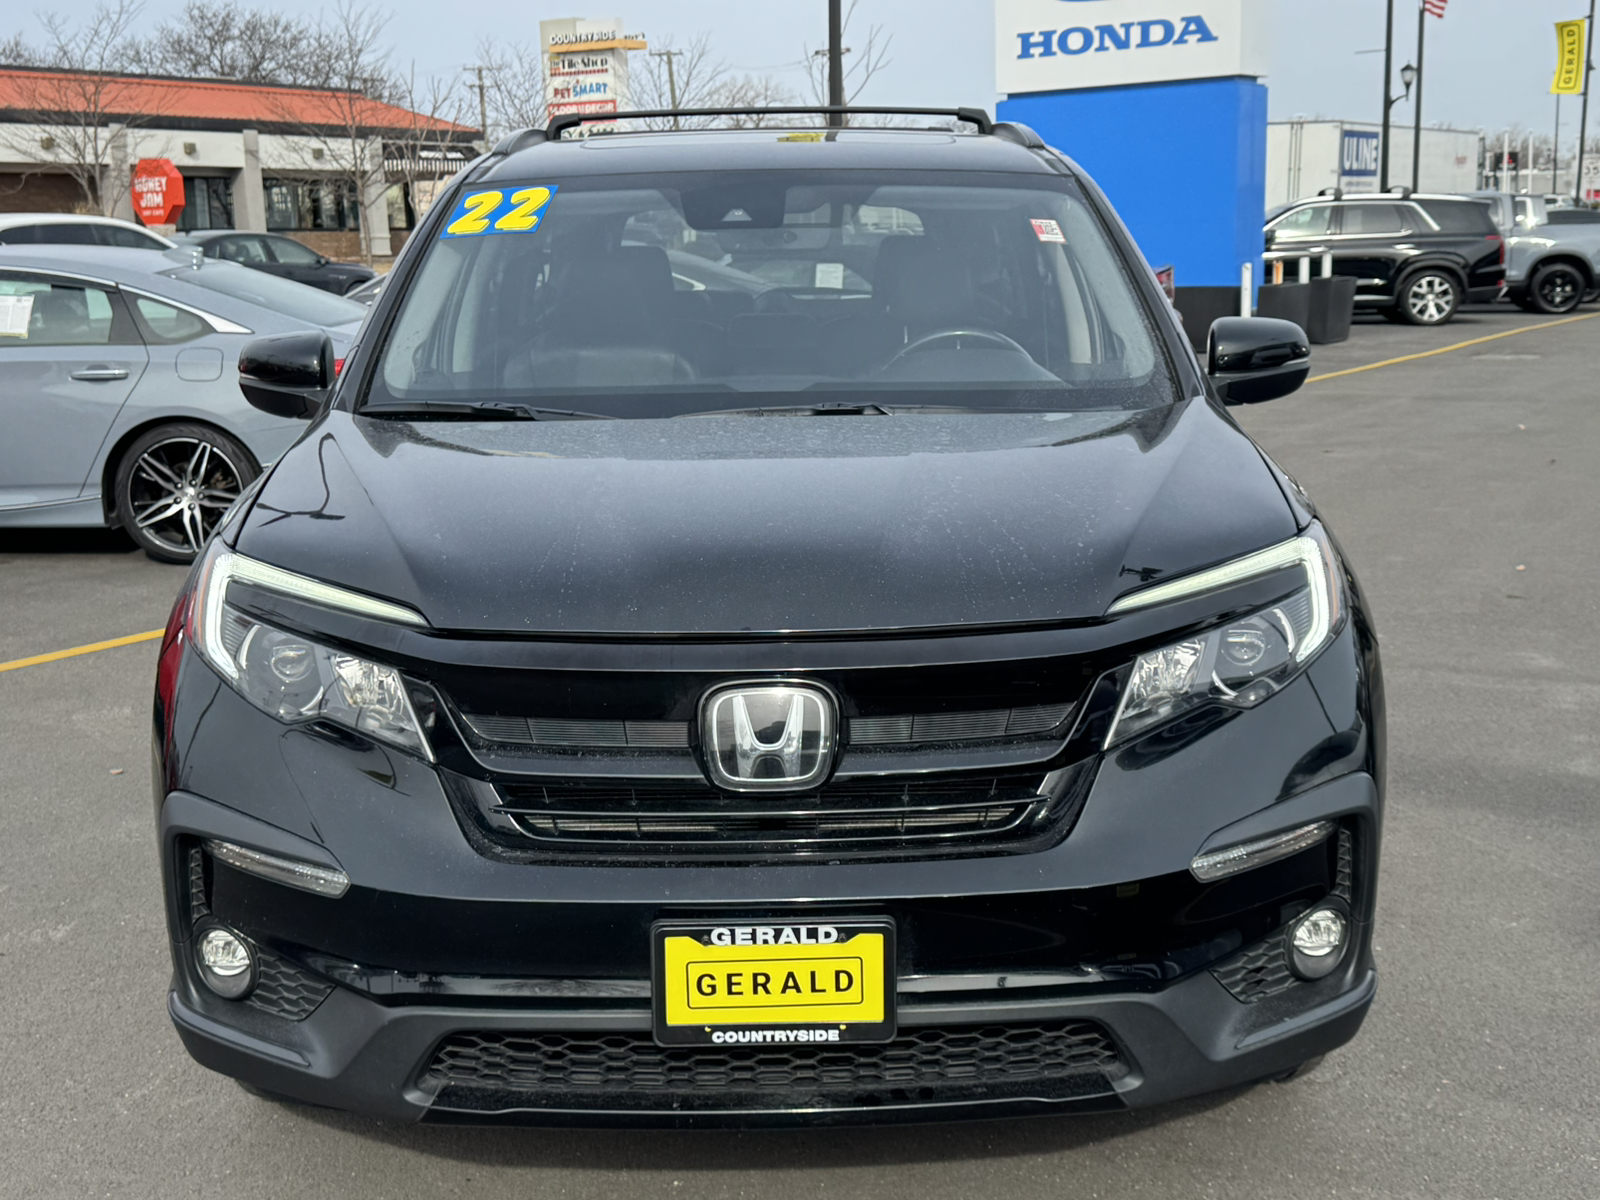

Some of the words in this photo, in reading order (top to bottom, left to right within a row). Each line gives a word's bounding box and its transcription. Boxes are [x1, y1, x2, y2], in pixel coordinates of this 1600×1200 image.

[549, 30, 616, 46] COUNTRYSIDE
[1017, 15, 1219, 59] HONDA
[561, 57, 579, 70] Tile
[581, 56, 608, 69] Shop
[1563, 29, 1576, 84] GERALD
[1344, 136, 1378, 170] ULINE
[447, 187, 551, 234] 22
[710, 926, 839, 946] GERALD
[696, 970, 854, 997] GERALD
[711, 1029, 840, 1044] COUNTRYSIDE
